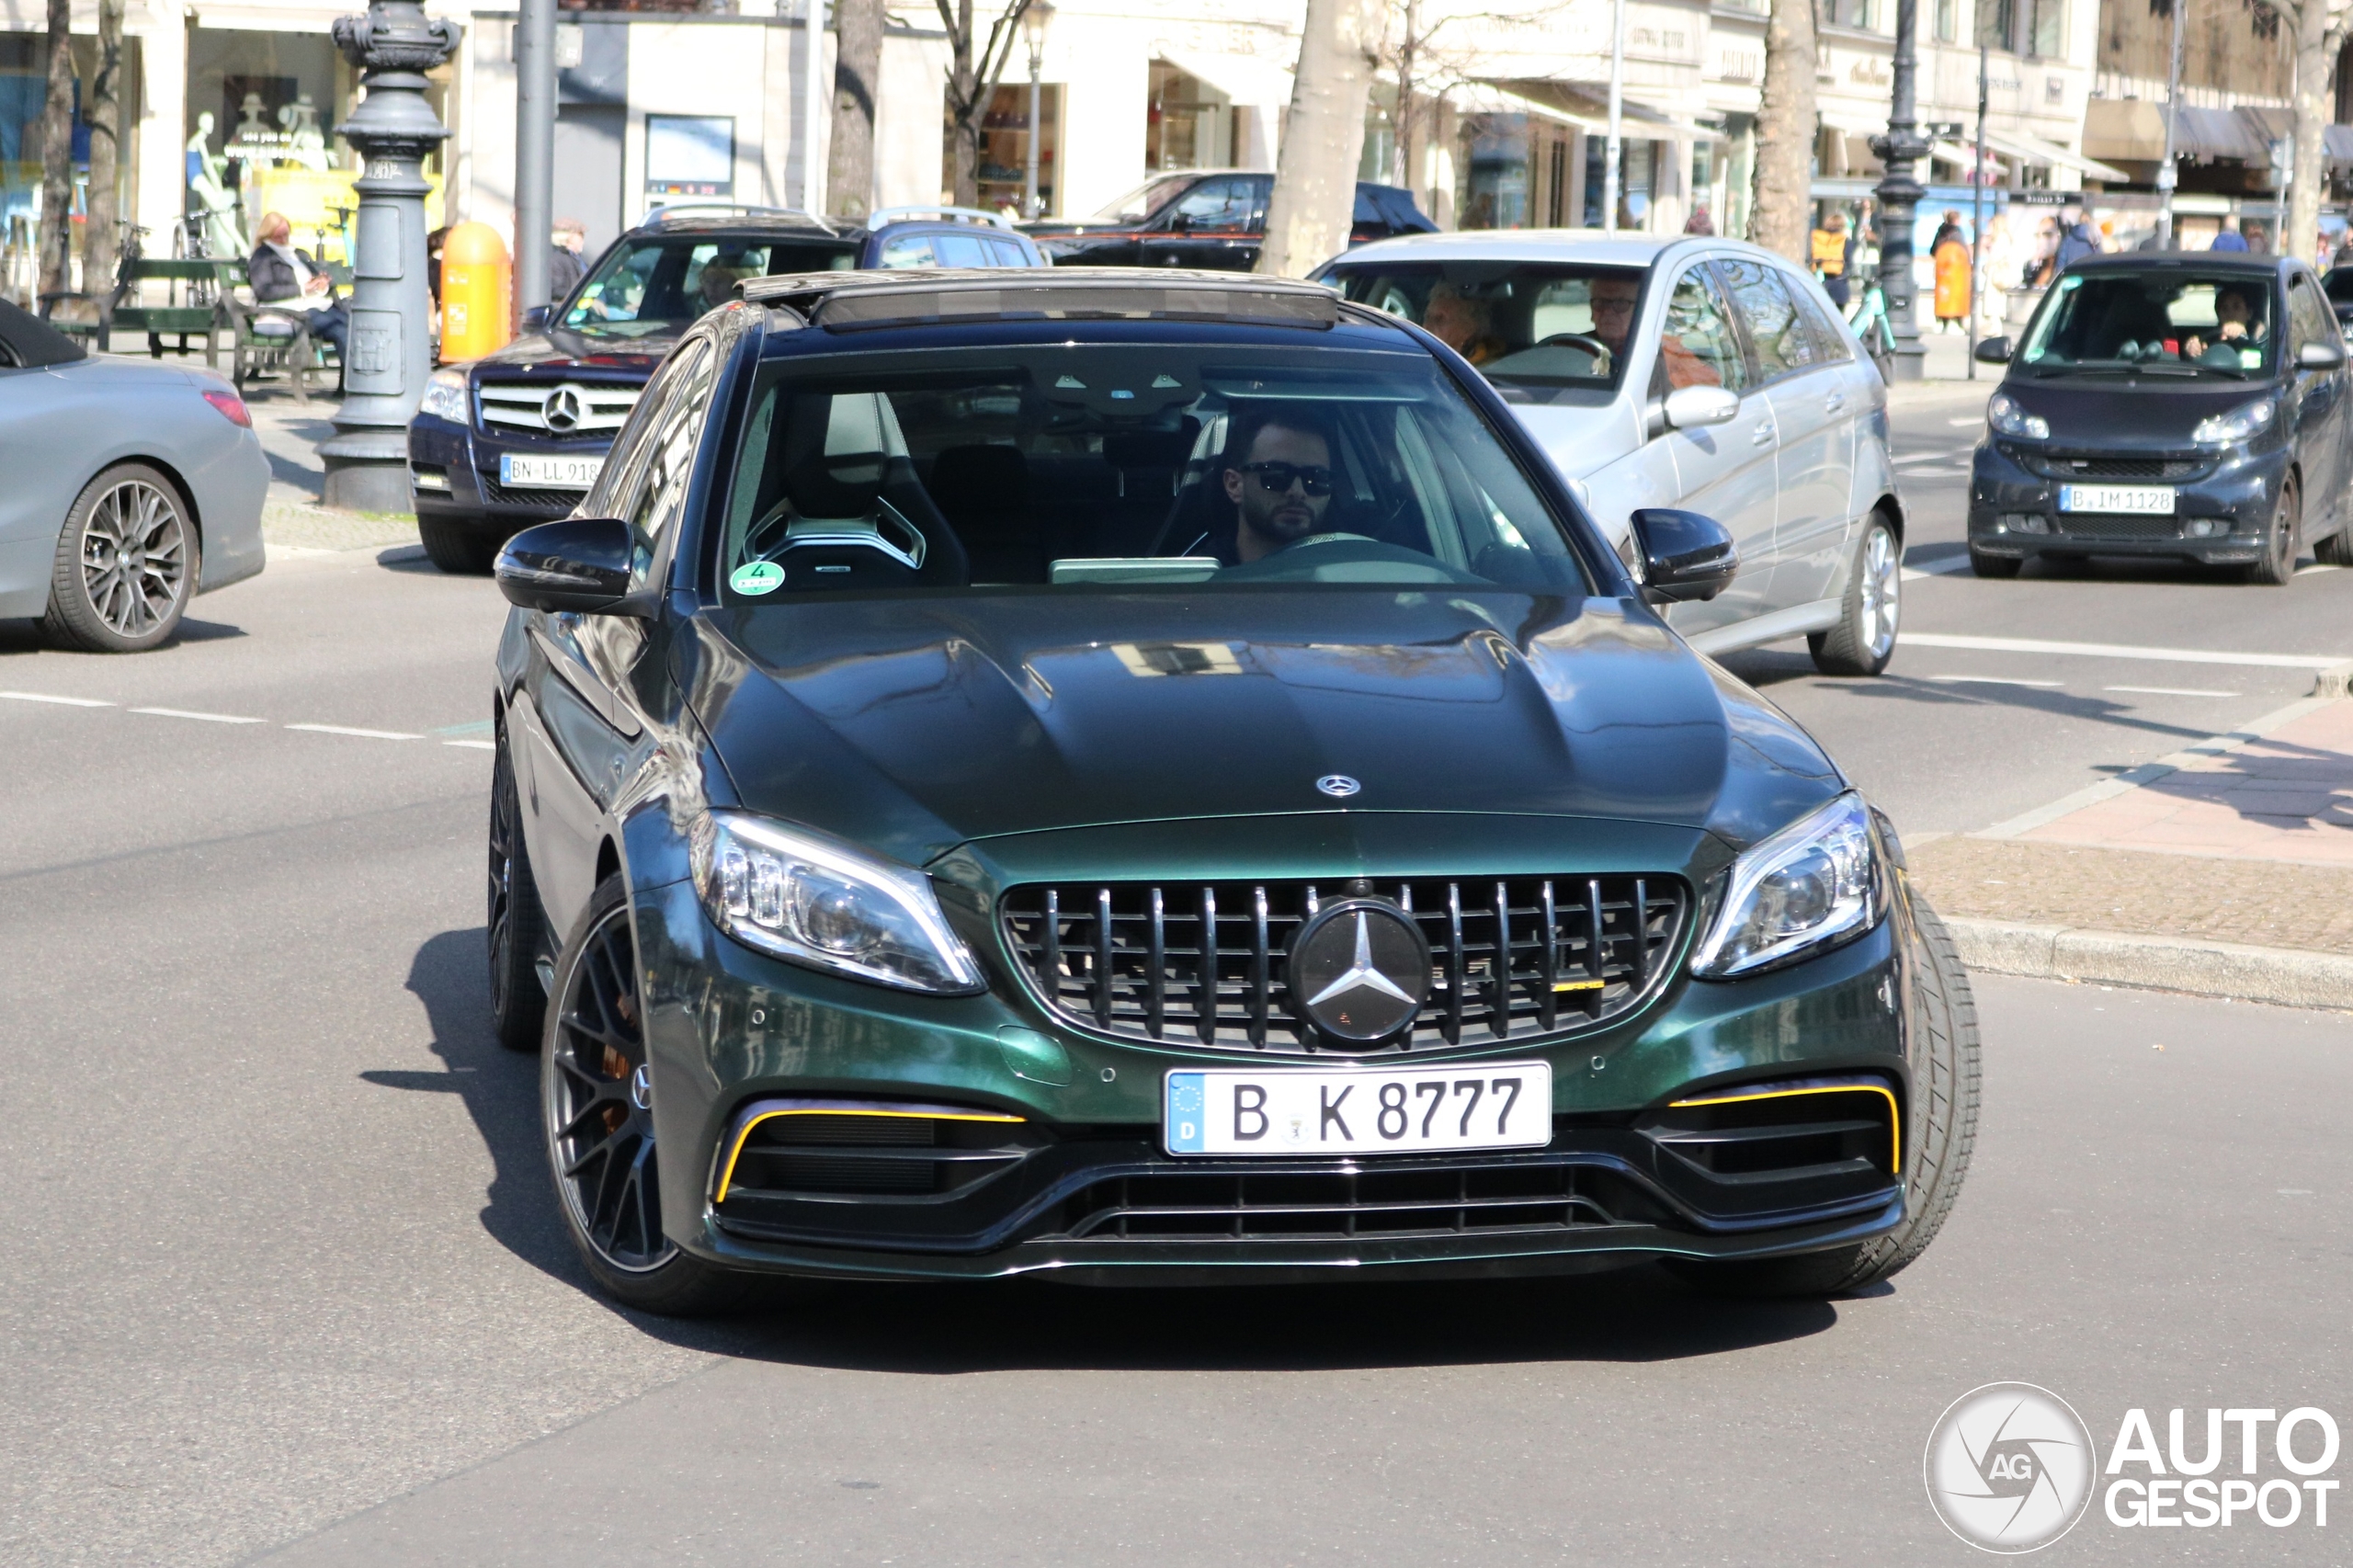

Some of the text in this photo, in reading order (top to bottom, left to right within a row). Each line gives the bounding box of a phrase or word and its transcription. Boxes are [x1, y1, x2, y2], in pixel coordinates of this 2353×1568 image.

[512, 460, 602, 482] BN LL 918
[2073, 490, 2085, 507] B
[2098, 491, 2120, 508] IM
[2125, 492, 2171, 510] 1128
[750, 563, 766, 578] 4
[1233, 1077, 1523, 1142] B K 8777
[1180, 1122, 1196, 1140] D
